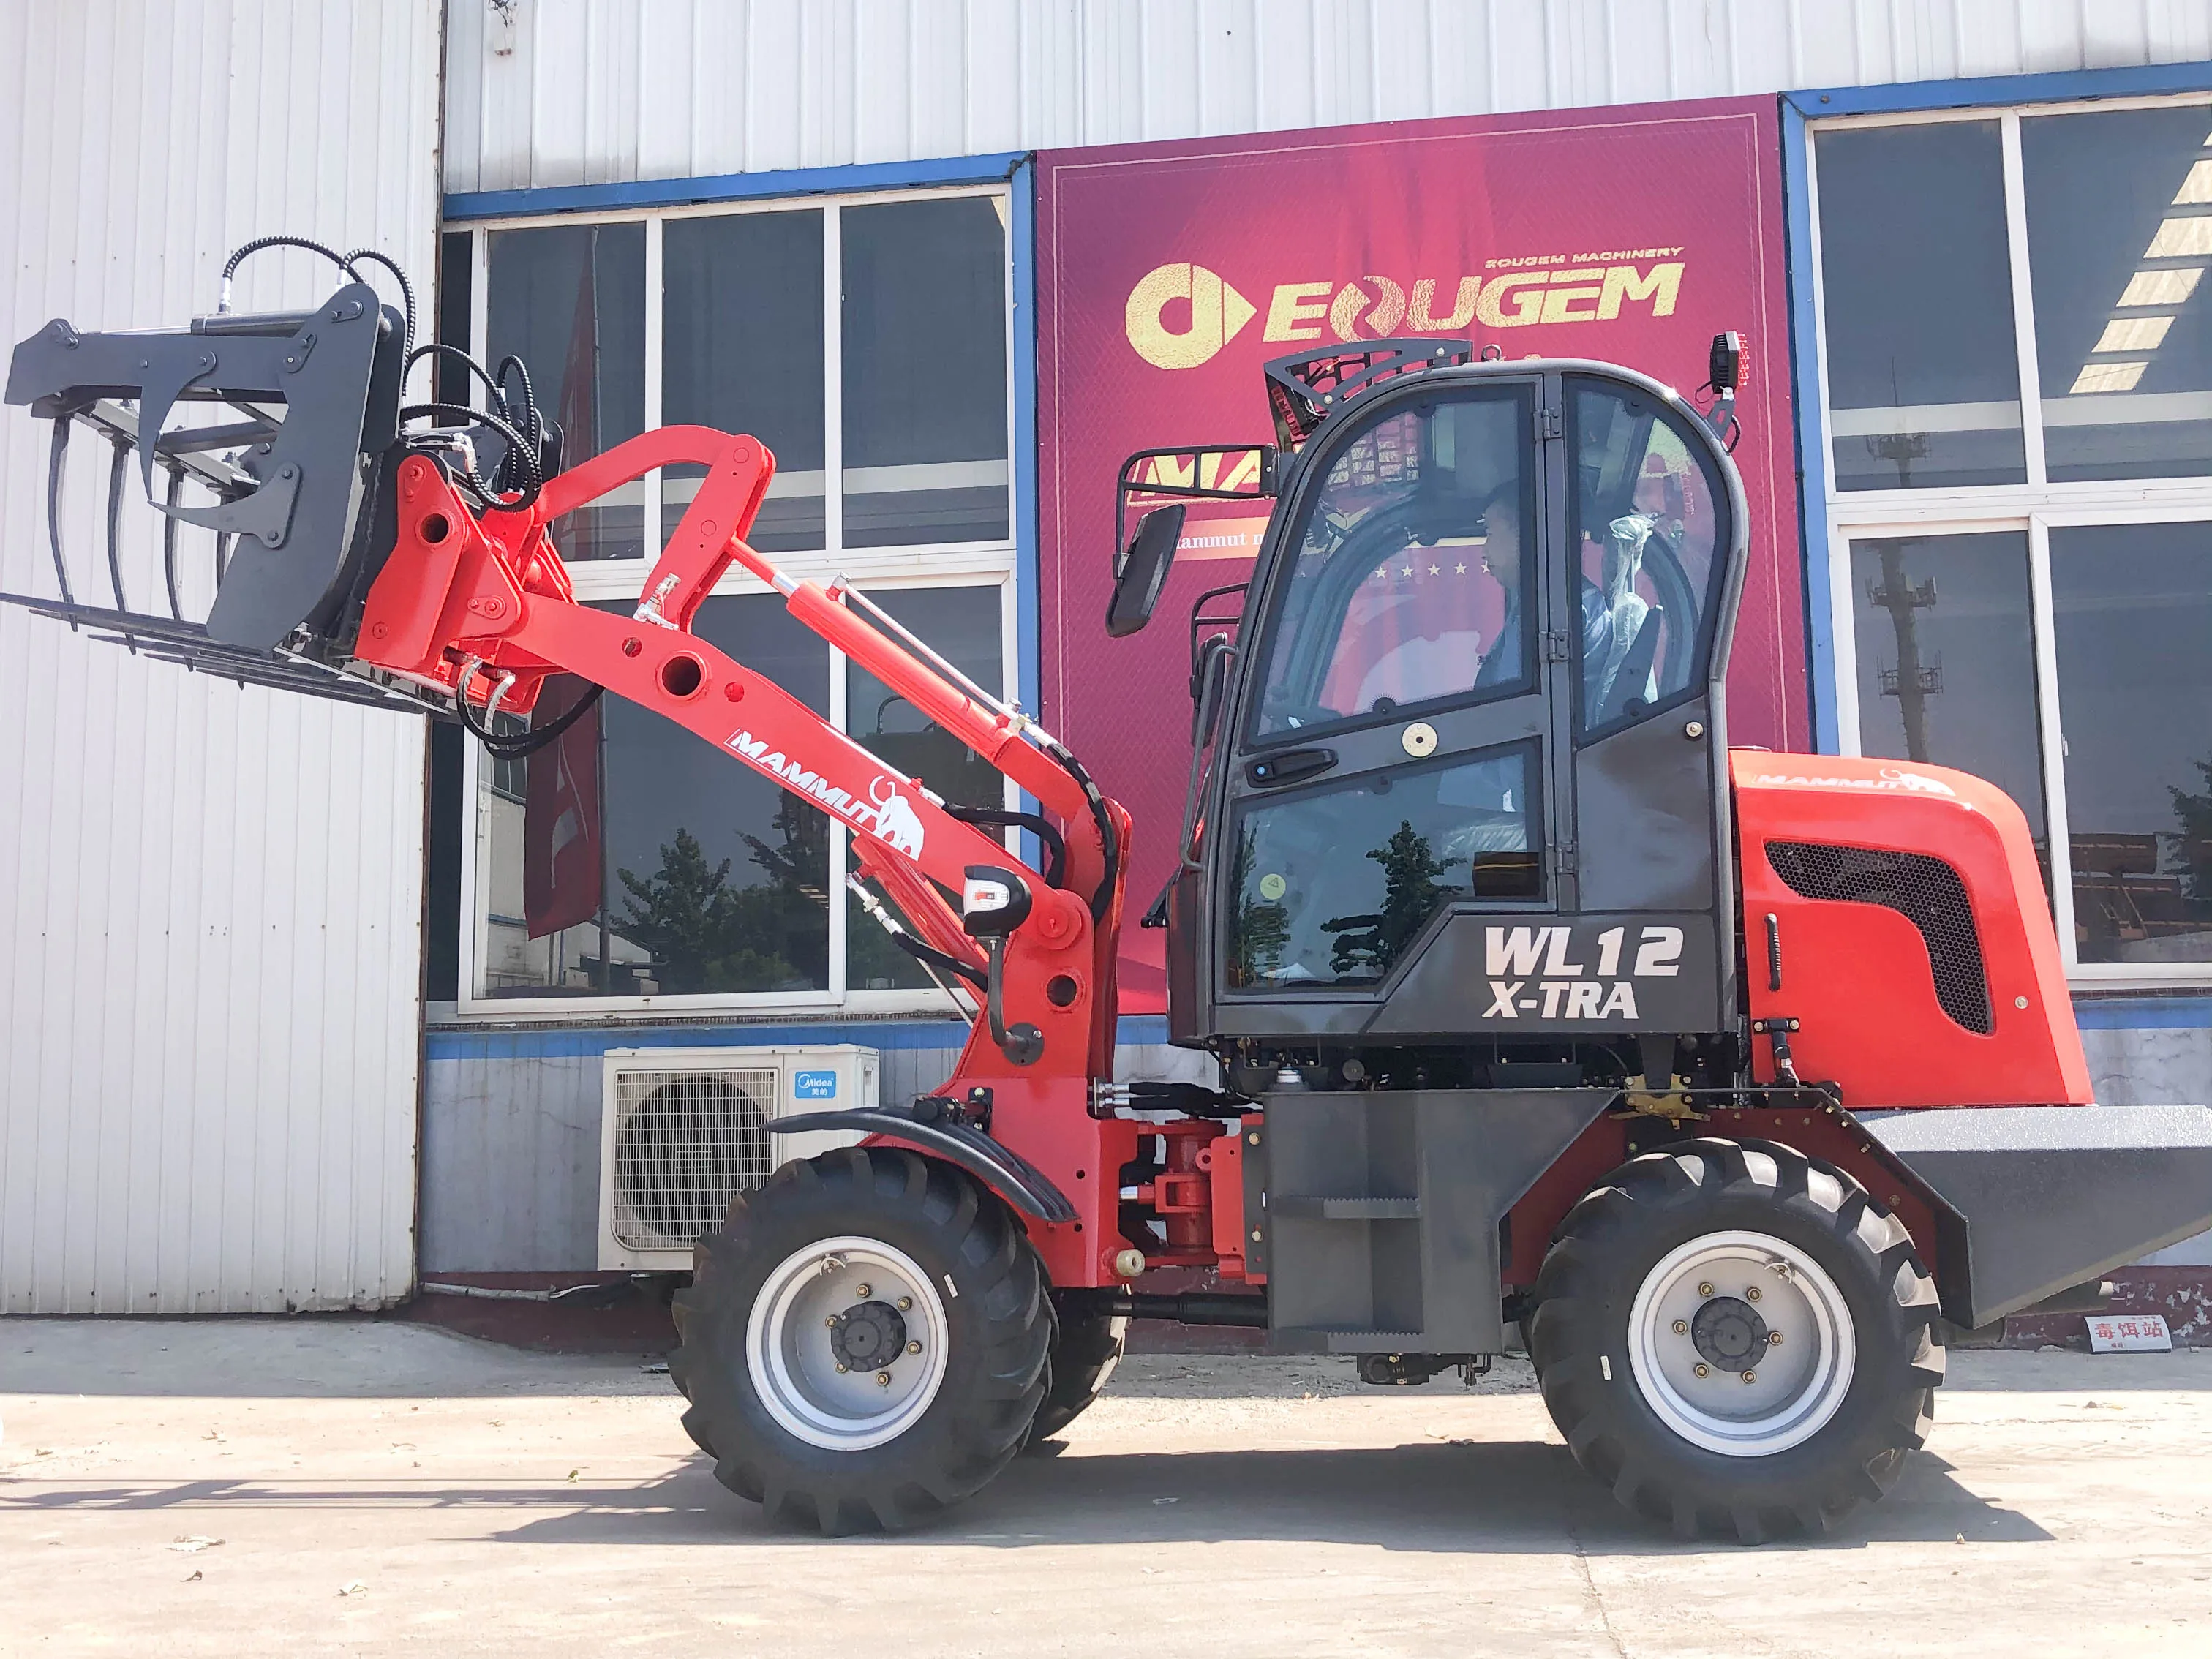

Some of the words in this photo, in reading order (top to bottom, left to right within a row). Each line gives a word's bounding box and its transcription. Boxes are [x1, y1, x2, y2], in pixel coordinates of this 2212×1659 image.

[1570, 247, 1685, 263] MACHINERY
[731, 730, 880, 824] MAMMUT
[1756, 774, 1903, 789] MAMMUT
[1481, 981, 1639, 1019] X-TRA
[798, 1074, 832, 1088] Midea
[2094, 1321, 2164, 1340] 毒饵站
